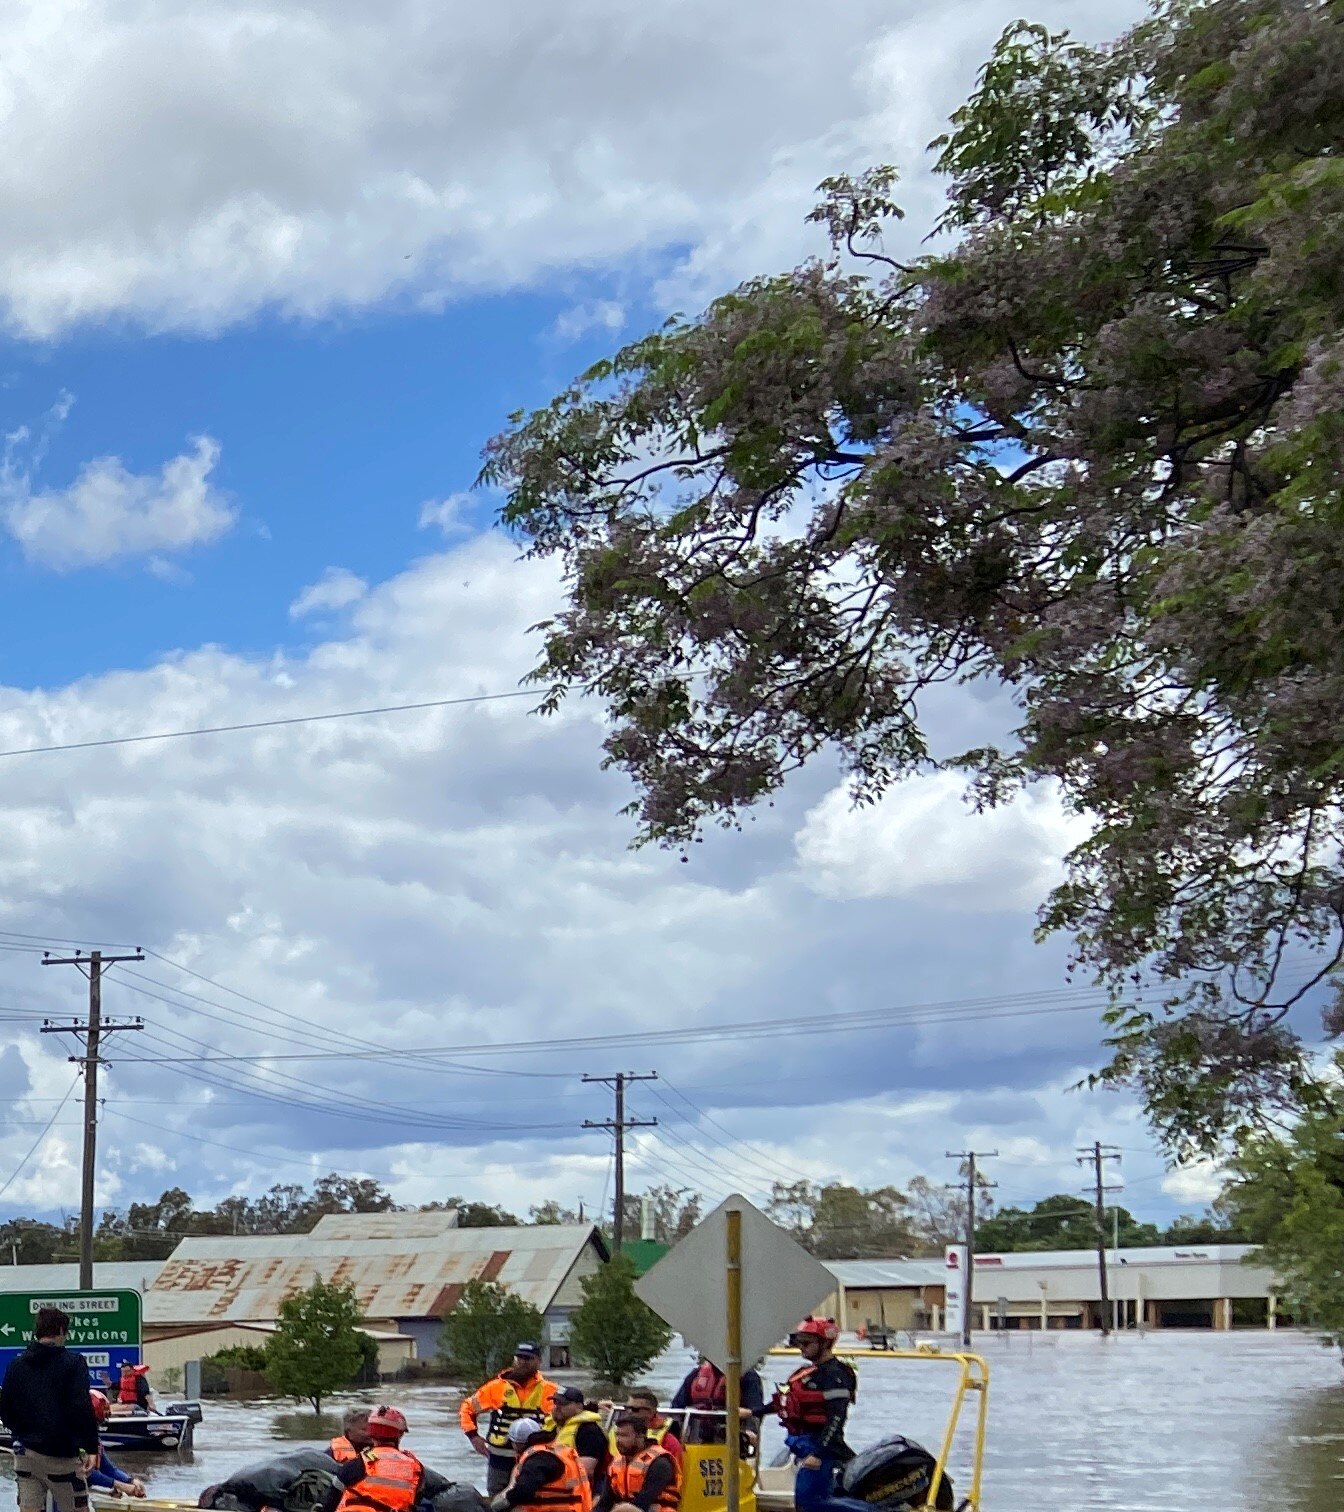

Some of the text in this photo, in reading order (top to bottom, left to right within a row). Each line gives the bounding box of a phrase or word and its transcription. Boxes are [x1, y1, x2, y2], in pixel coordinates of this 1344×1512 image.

[80, 1300, 115, 1309] STREET
[699, 1459, 724, 1477] SES
[703, 1479, 724, 1497] J22
